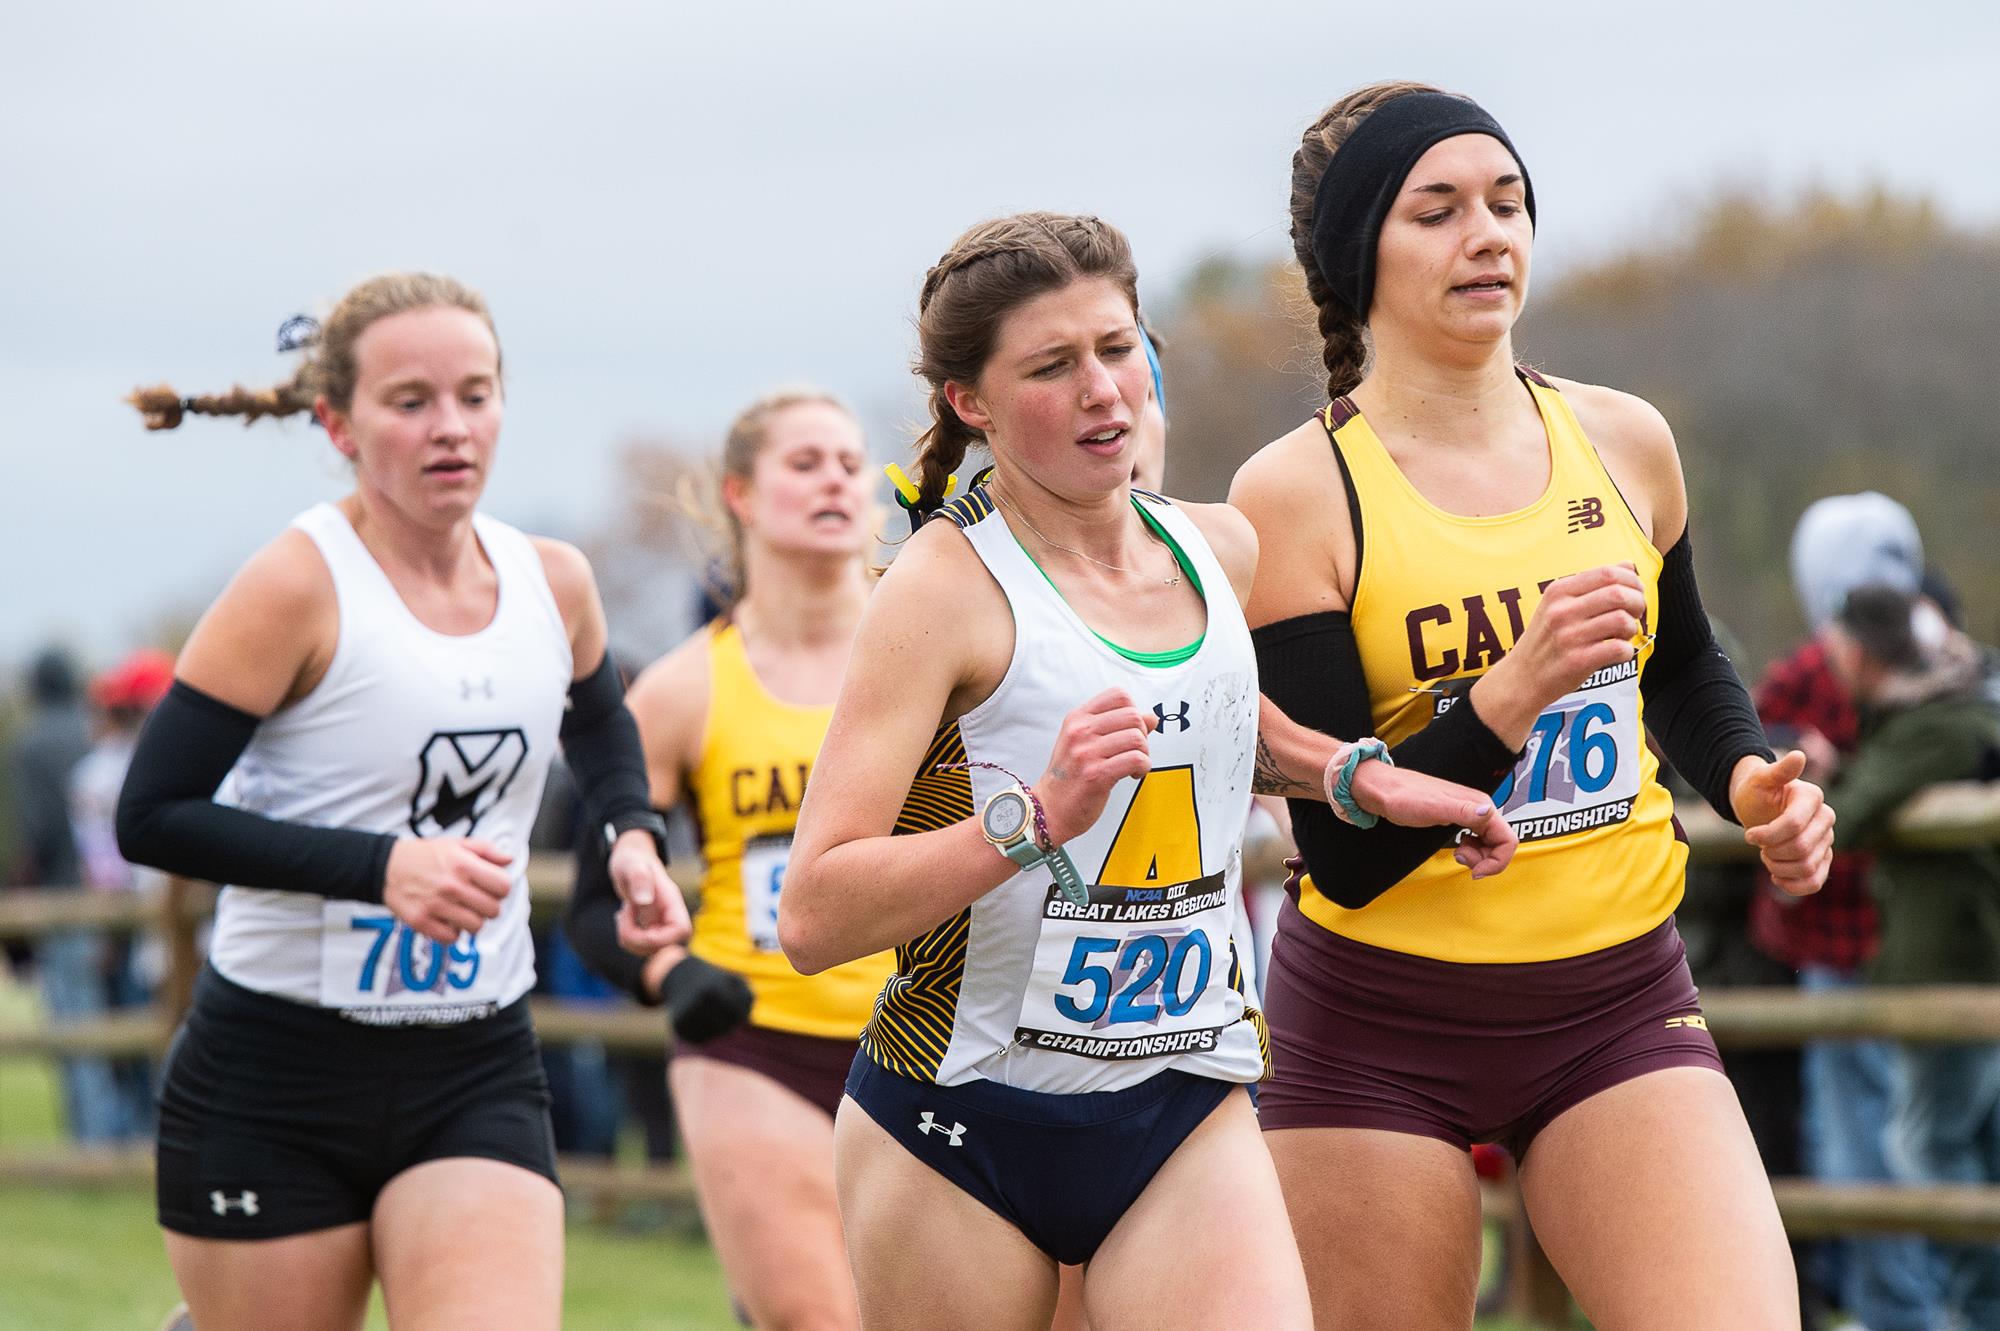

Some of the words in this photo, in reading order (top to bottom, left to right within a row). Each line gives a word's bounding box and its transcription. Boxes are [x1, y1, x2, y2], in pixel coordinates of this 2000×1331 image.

[1492, 702, 1617, 808] 76
[1096, 764, 1204, 887] A
[1047, 901, 1112, 920] GREAT
[1113, 903, 1170, 920] LAKES
[1172, 889, 1226, 917] REGIONA
[1125, 890, 1162, 902] NCAA
[1167, 884, 1188, 901] DIII
[351, 917, 480, 992] 709
[1055, 929, 1212, 1023] 520
[1037, 1032, 1213, 1057] CHAMPIONSHIPS
